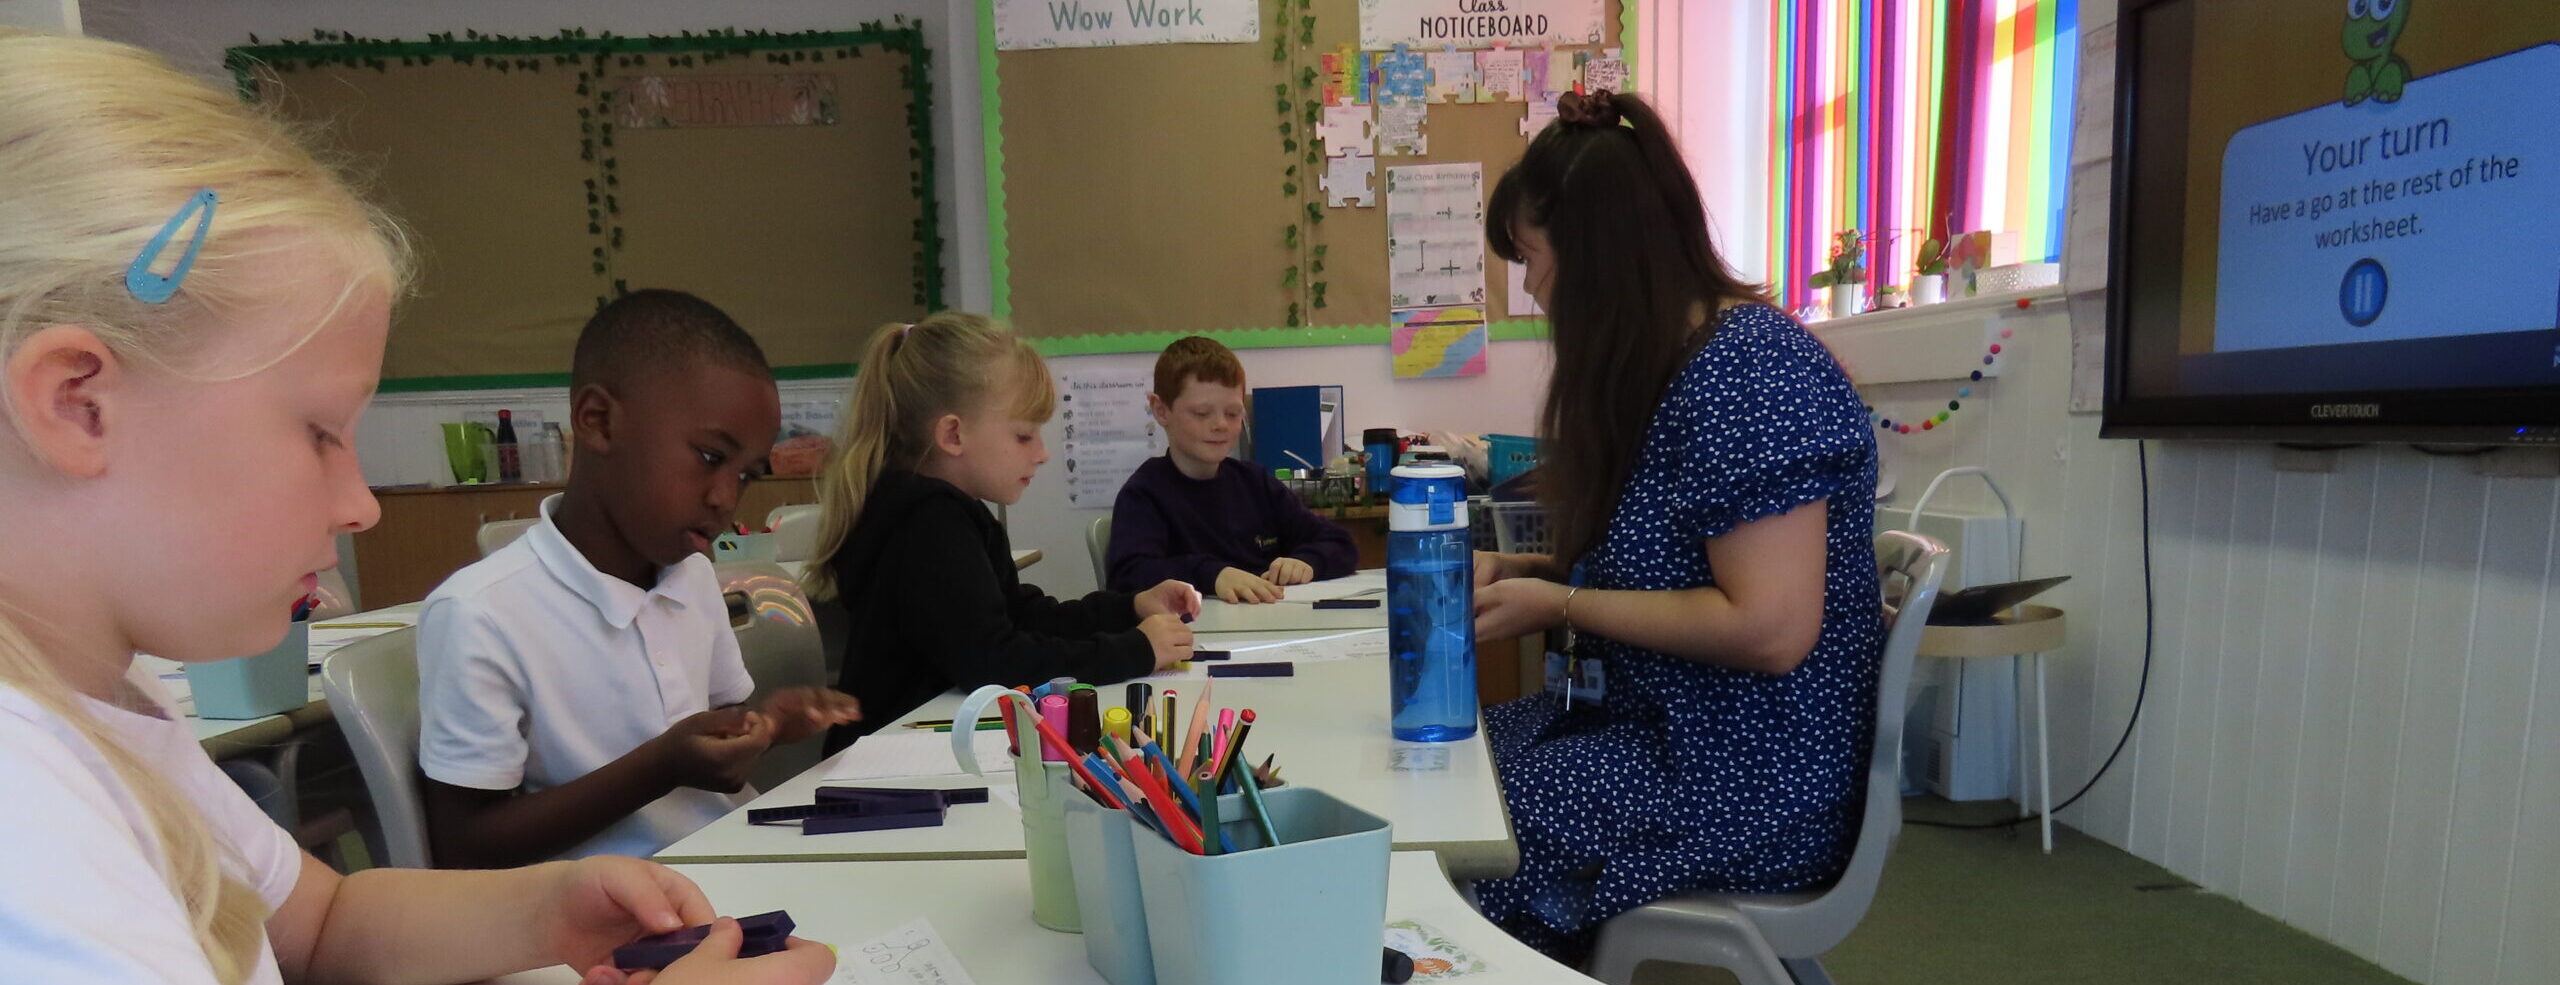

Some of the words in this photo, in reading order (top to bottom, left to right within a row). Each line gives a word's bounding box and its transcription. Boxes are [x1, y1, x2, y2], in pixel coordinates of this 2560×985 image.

[1049, 1, 1113, 31] Wow
[1127, 0, 1204, 28] Work
[1459, 0, 1508, 13] Class
[1420, 15, 1548, 38] NOTICEBOARD
[2304, 136, 2371, 176] Your
[2381, 118, 2449, 160] turn
[2250, 202, 2290, 225] Have
[2296, 200, 2305, 217] a
[2311, 195, 2332, 220] go
[2340, 186, 2357, 209] at
[2363, 179, 2396, 205] the
[2402, 169, 2442, 197] rest
[2450, 158, 2474, 189] of
[2480, 154, 2519, 183] the
[2315, 213, 2423, 249] worksheet.
[2311, 404, 2379, 418] CLEVERTOUCH
